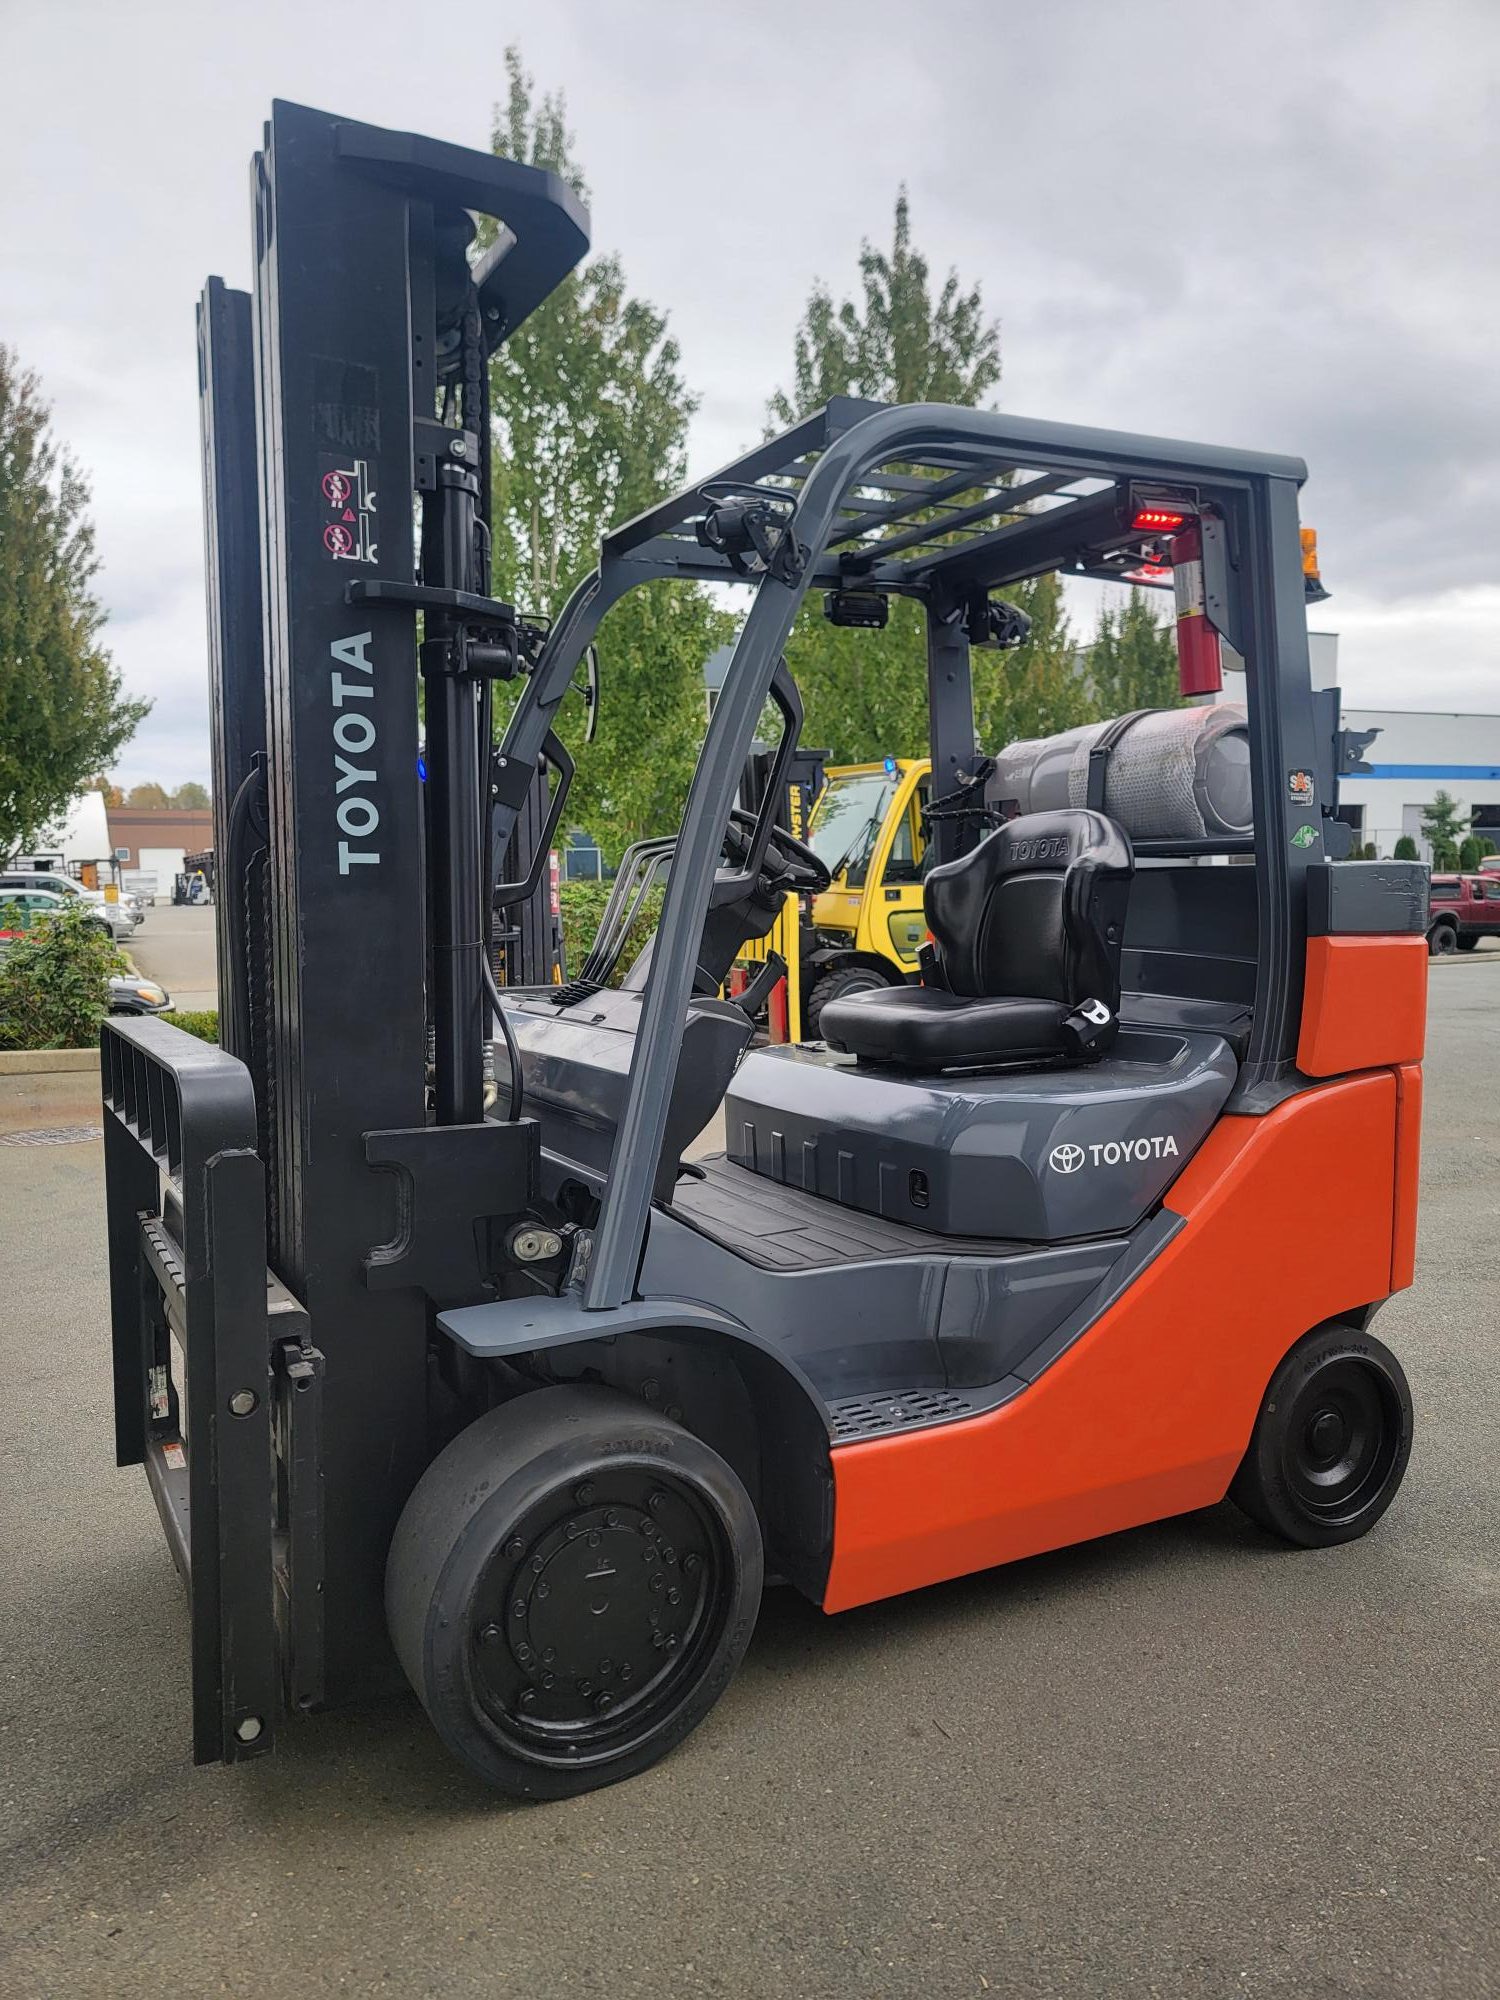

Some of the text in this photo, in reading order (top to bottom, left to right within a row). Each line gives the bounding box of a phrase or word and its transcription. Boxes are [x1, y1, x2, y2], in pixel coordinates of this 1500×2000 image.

[330, 631, 381, 875] TOYOTA
[1290, 772, 1311, 791] SAS
[1010, 837, 1070, 861] TOYOTA
[1089, 1136, 1179, 1167] TOYOTA
